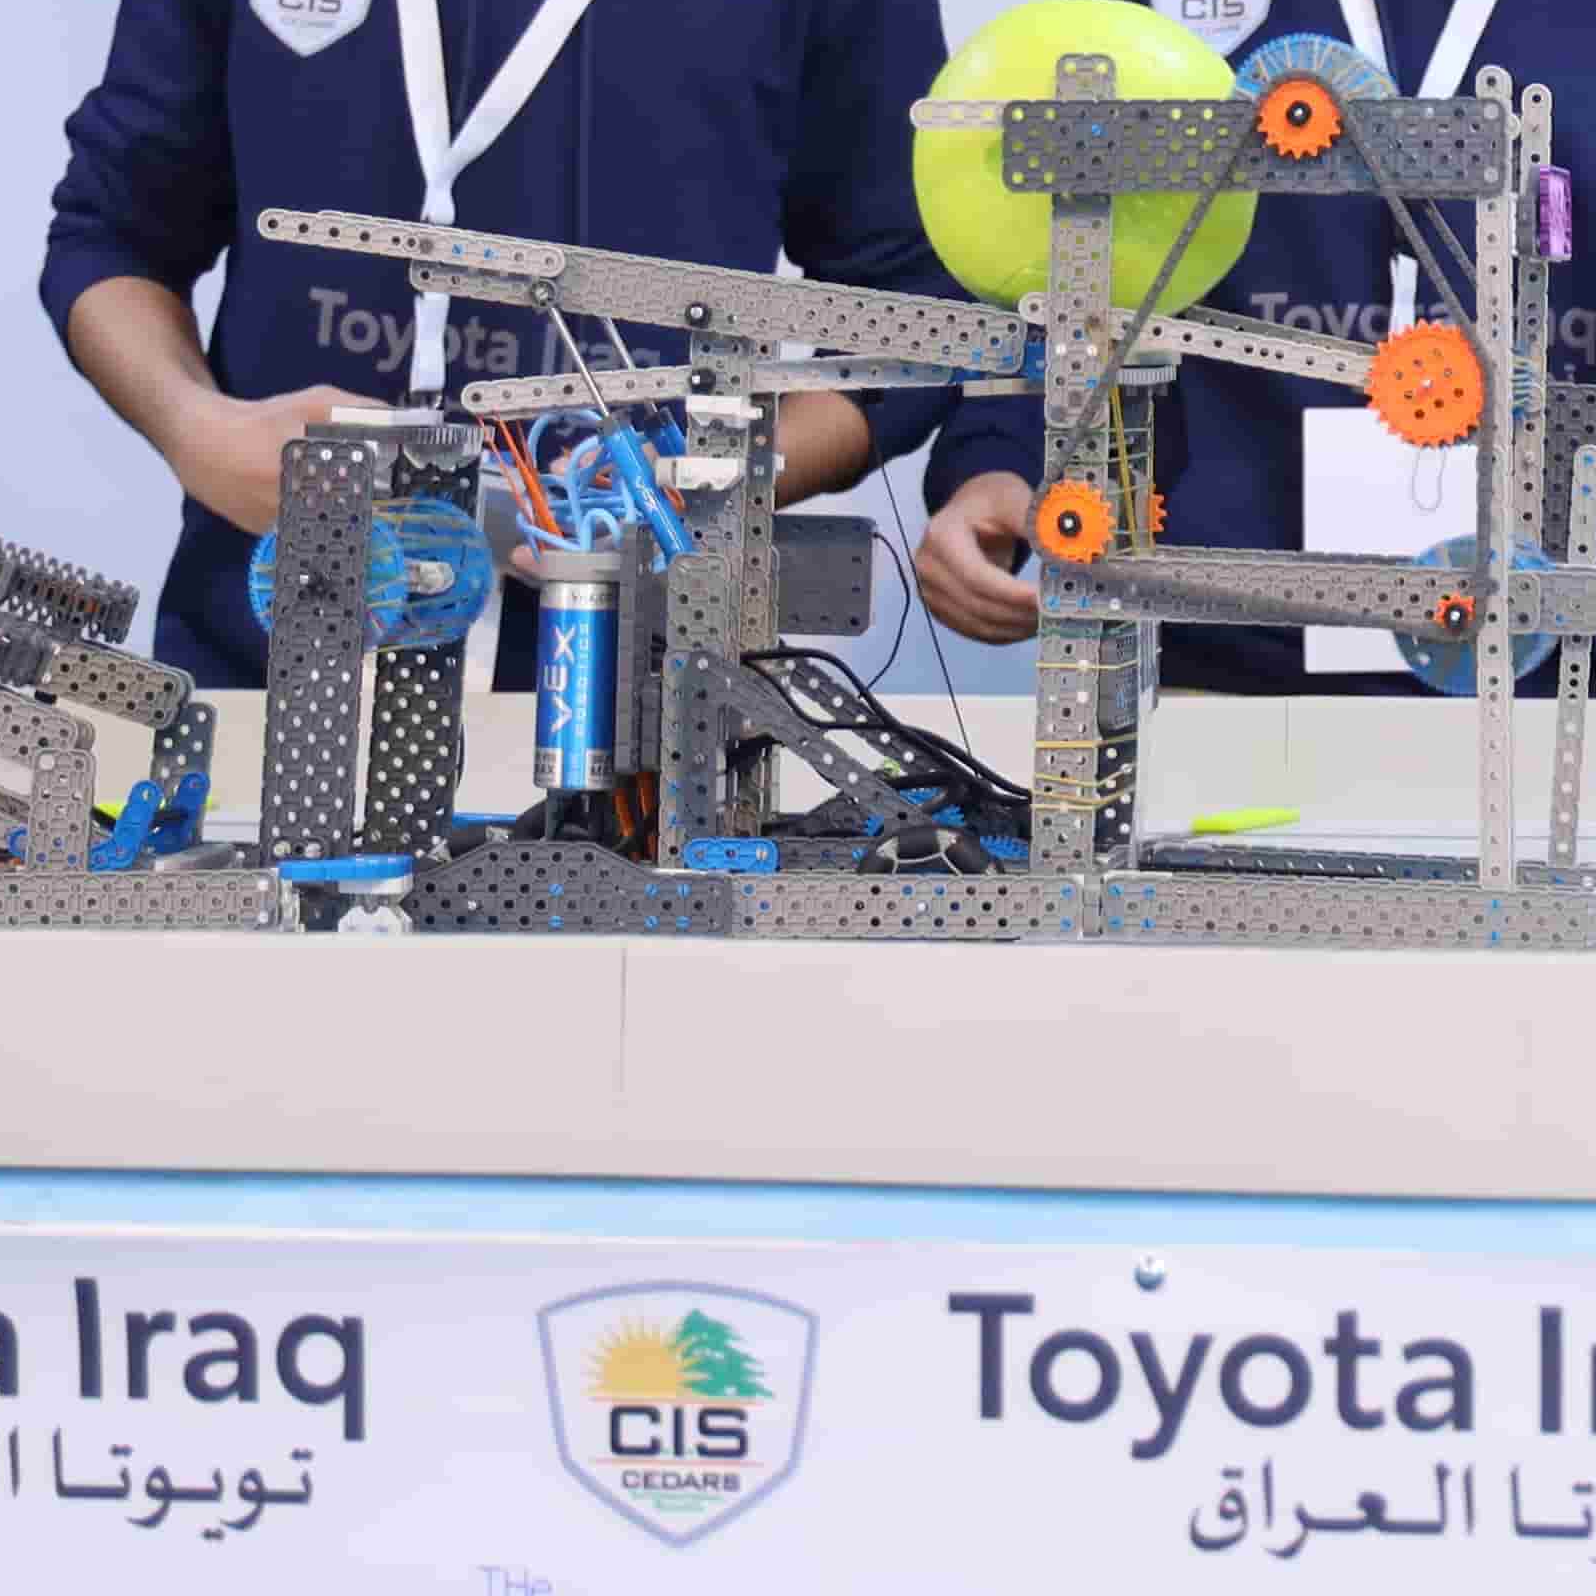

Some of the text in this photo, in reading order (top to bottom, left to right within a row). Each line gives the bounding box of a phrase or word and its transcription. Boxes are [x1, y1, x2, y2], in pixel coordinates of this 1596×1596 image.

[542, 624, 578, 734] VEX
[74, 1276, 366, 1444] Iraq
[947, 1292, 1477, 1461] Toyota
[51, 1422, 316, 1542] تويوتا
[608, 1404, 751, 1461] CIS
[619, 1468, 742, 1493] CEDARS
[1187, 1457, 1476, 1561] العراق
